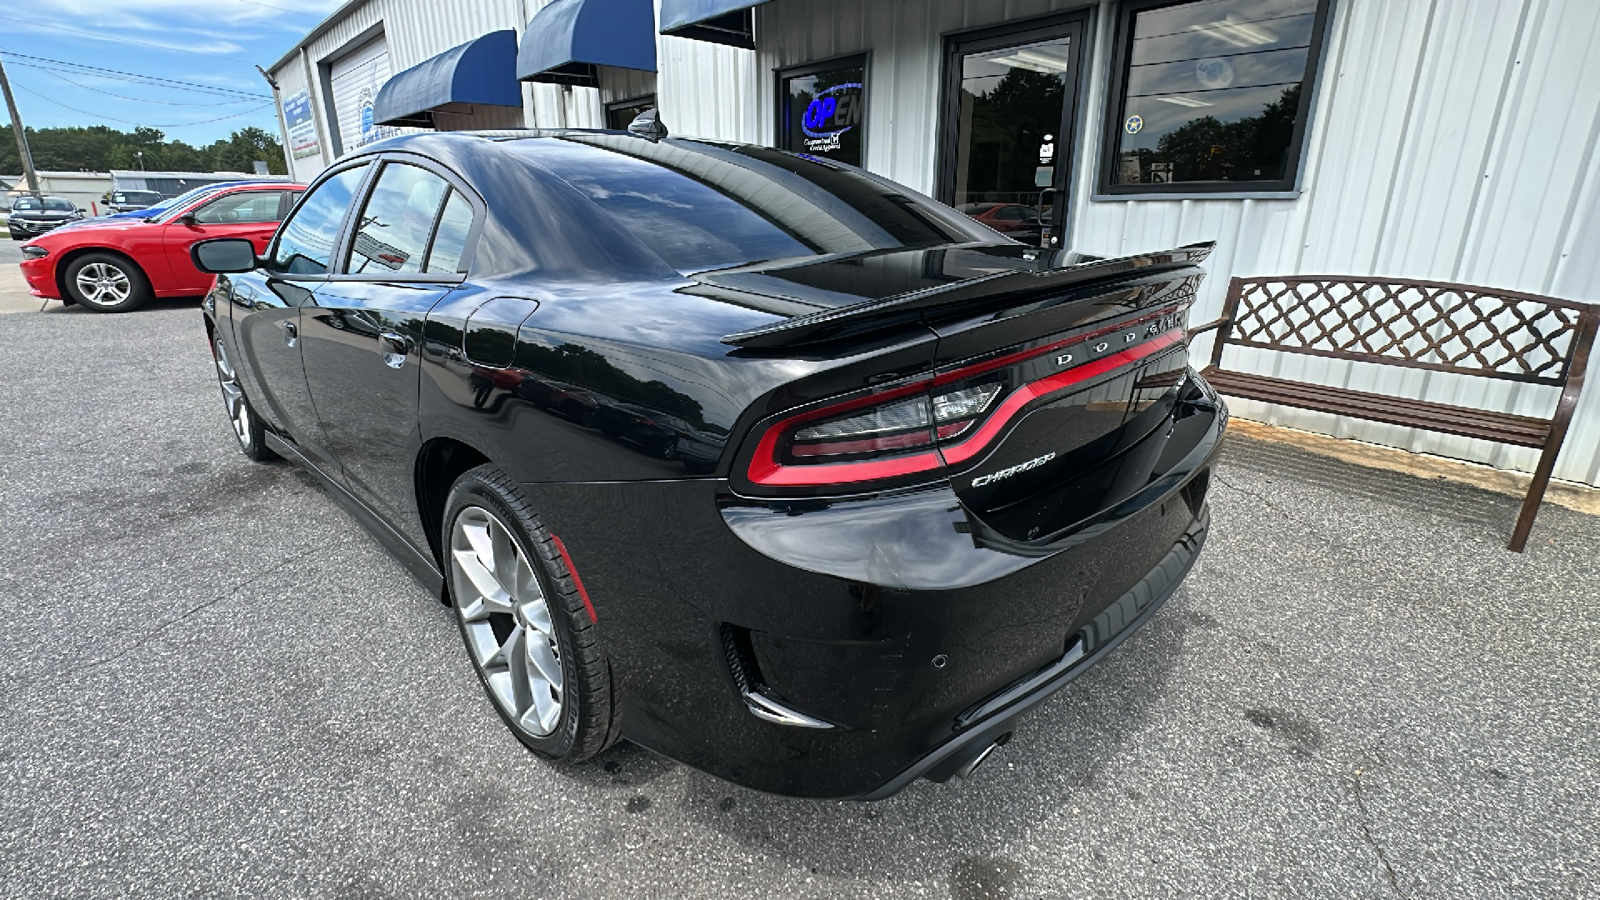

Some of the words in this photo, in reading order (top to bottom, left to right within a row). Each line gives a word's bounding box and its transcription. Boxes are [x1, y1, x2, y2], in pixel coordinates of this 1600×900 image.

[805, 94, 862, 128] OPEN
[1057, 316, 1174, 365] DODGE
[971, 451, 1056, 488] CHARGER
